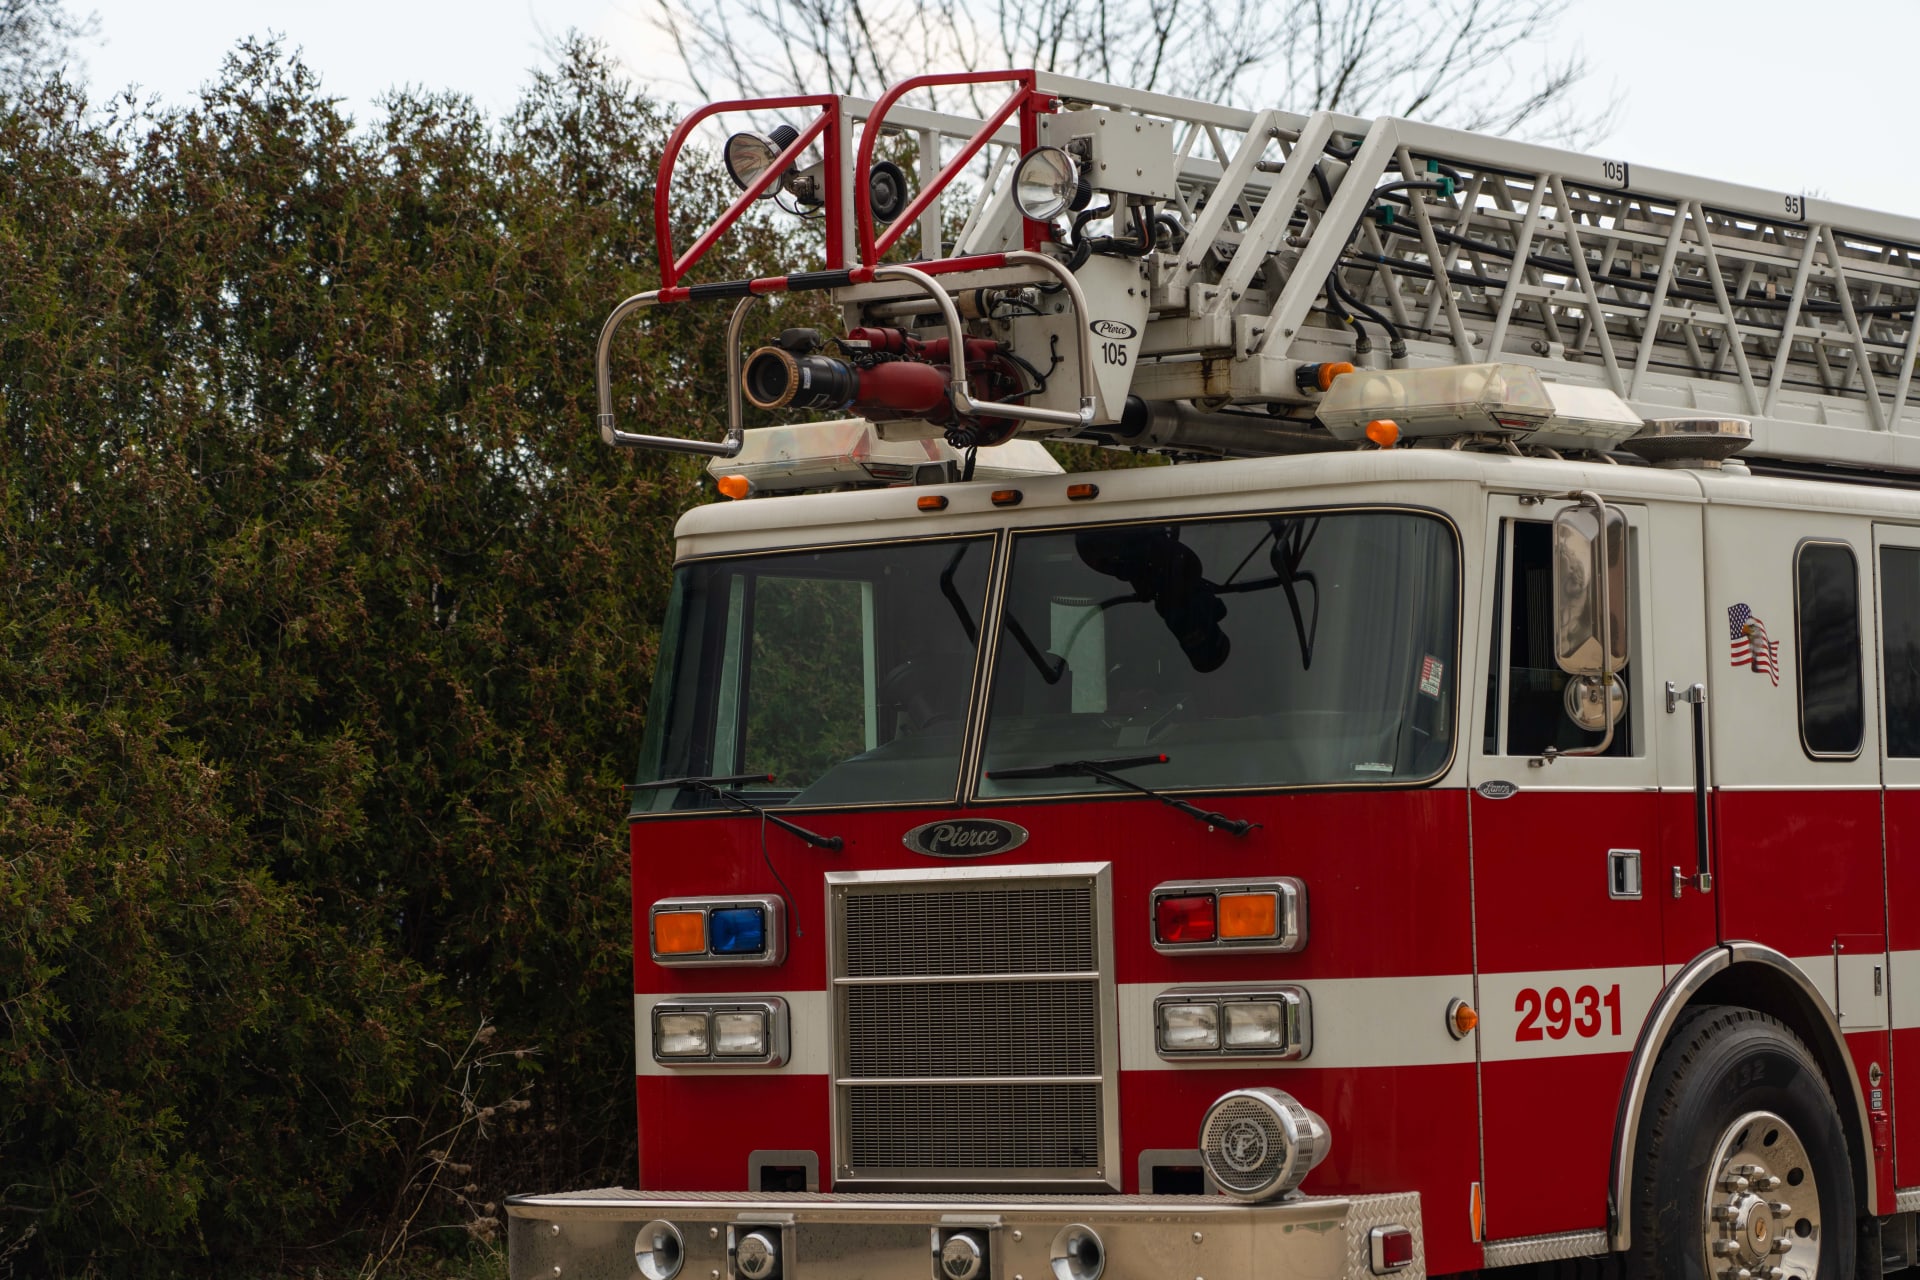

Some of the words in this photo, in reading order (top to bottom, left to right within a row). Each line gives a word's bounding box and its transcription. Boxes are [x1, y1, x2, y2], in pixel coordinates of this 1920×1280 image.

[1602, 161, 1623, 181] 105
[1785, 196, 1798, 214] 95
[1100, 321, 1127, 335] Pierce
[1101, 341, 1127, 367] 105
[929, 824, 999, 852] Pierce
[1514, 984, 1622, 1042] 2931
